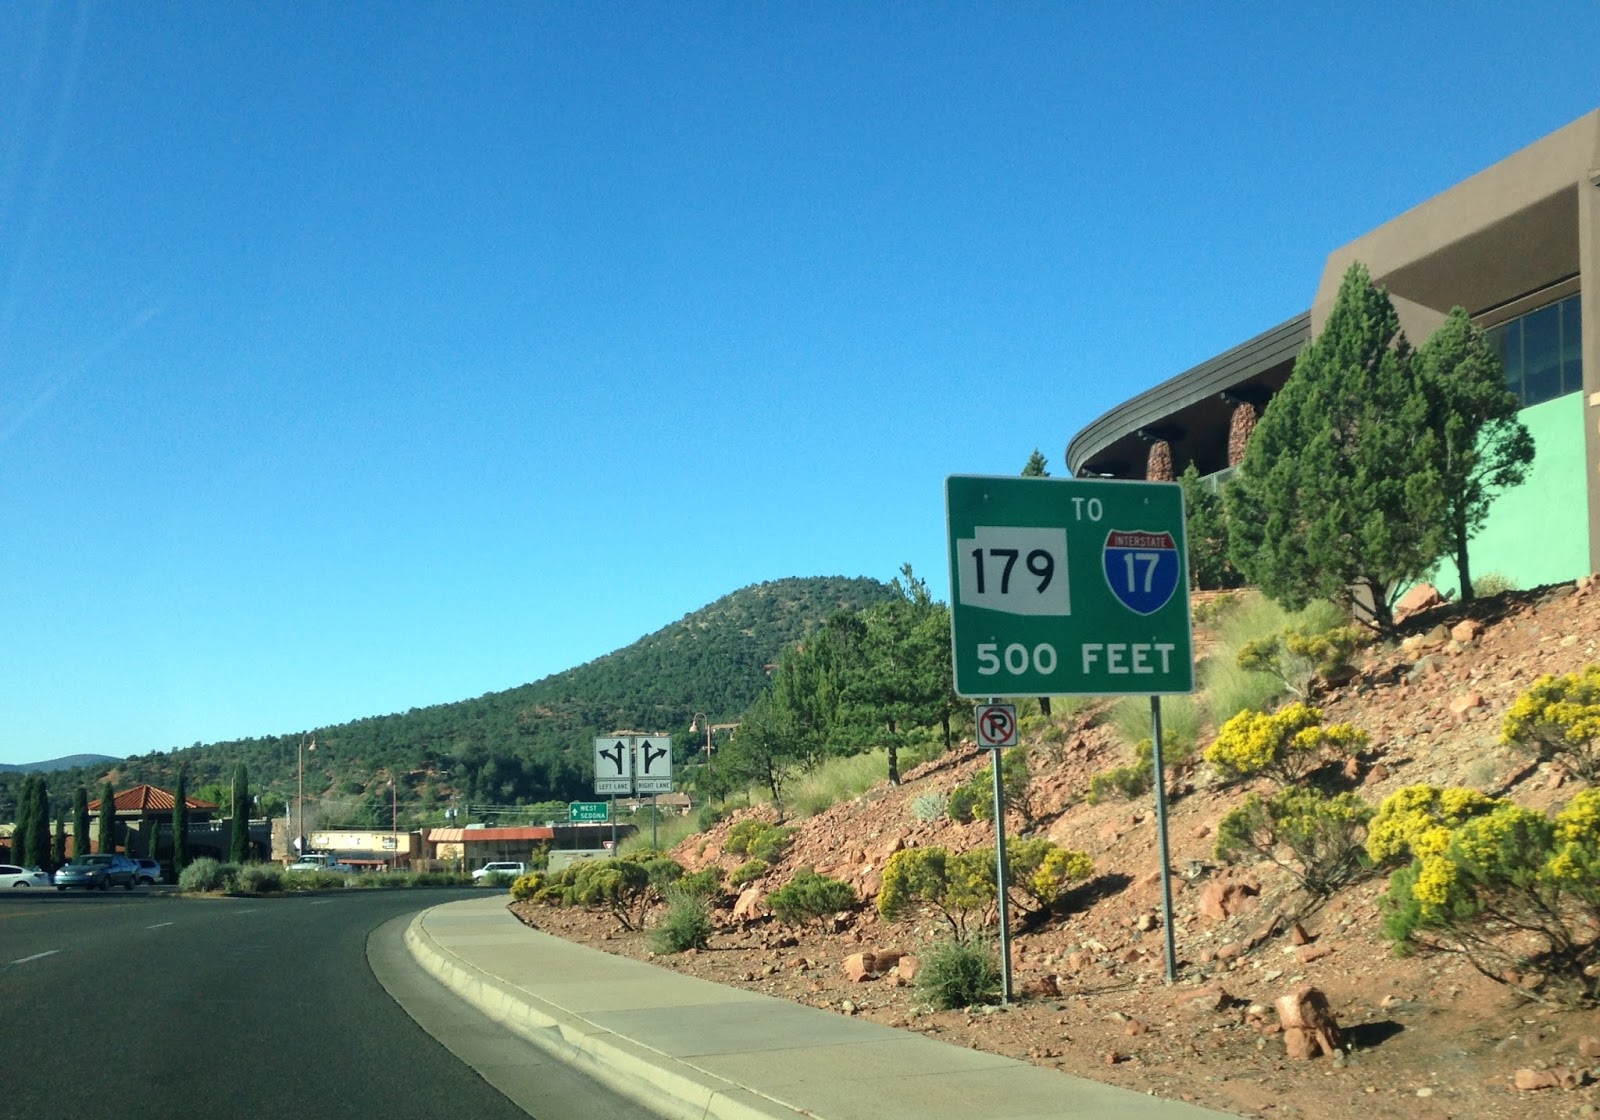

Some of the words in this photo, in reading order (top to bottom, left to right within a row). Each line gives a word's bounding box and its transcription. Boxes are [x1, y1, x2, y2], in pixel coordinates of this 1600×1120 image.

[1071, 497, 1104, 521] TO
[1114, 535, 1167, 548] INTERSTATE
[971, 548, 1055, 595] 179
[1123, 552, 1161, 593] 17
[976, 642, 1058, 675] 500
[1081, 643, 1176, 674] FEET
